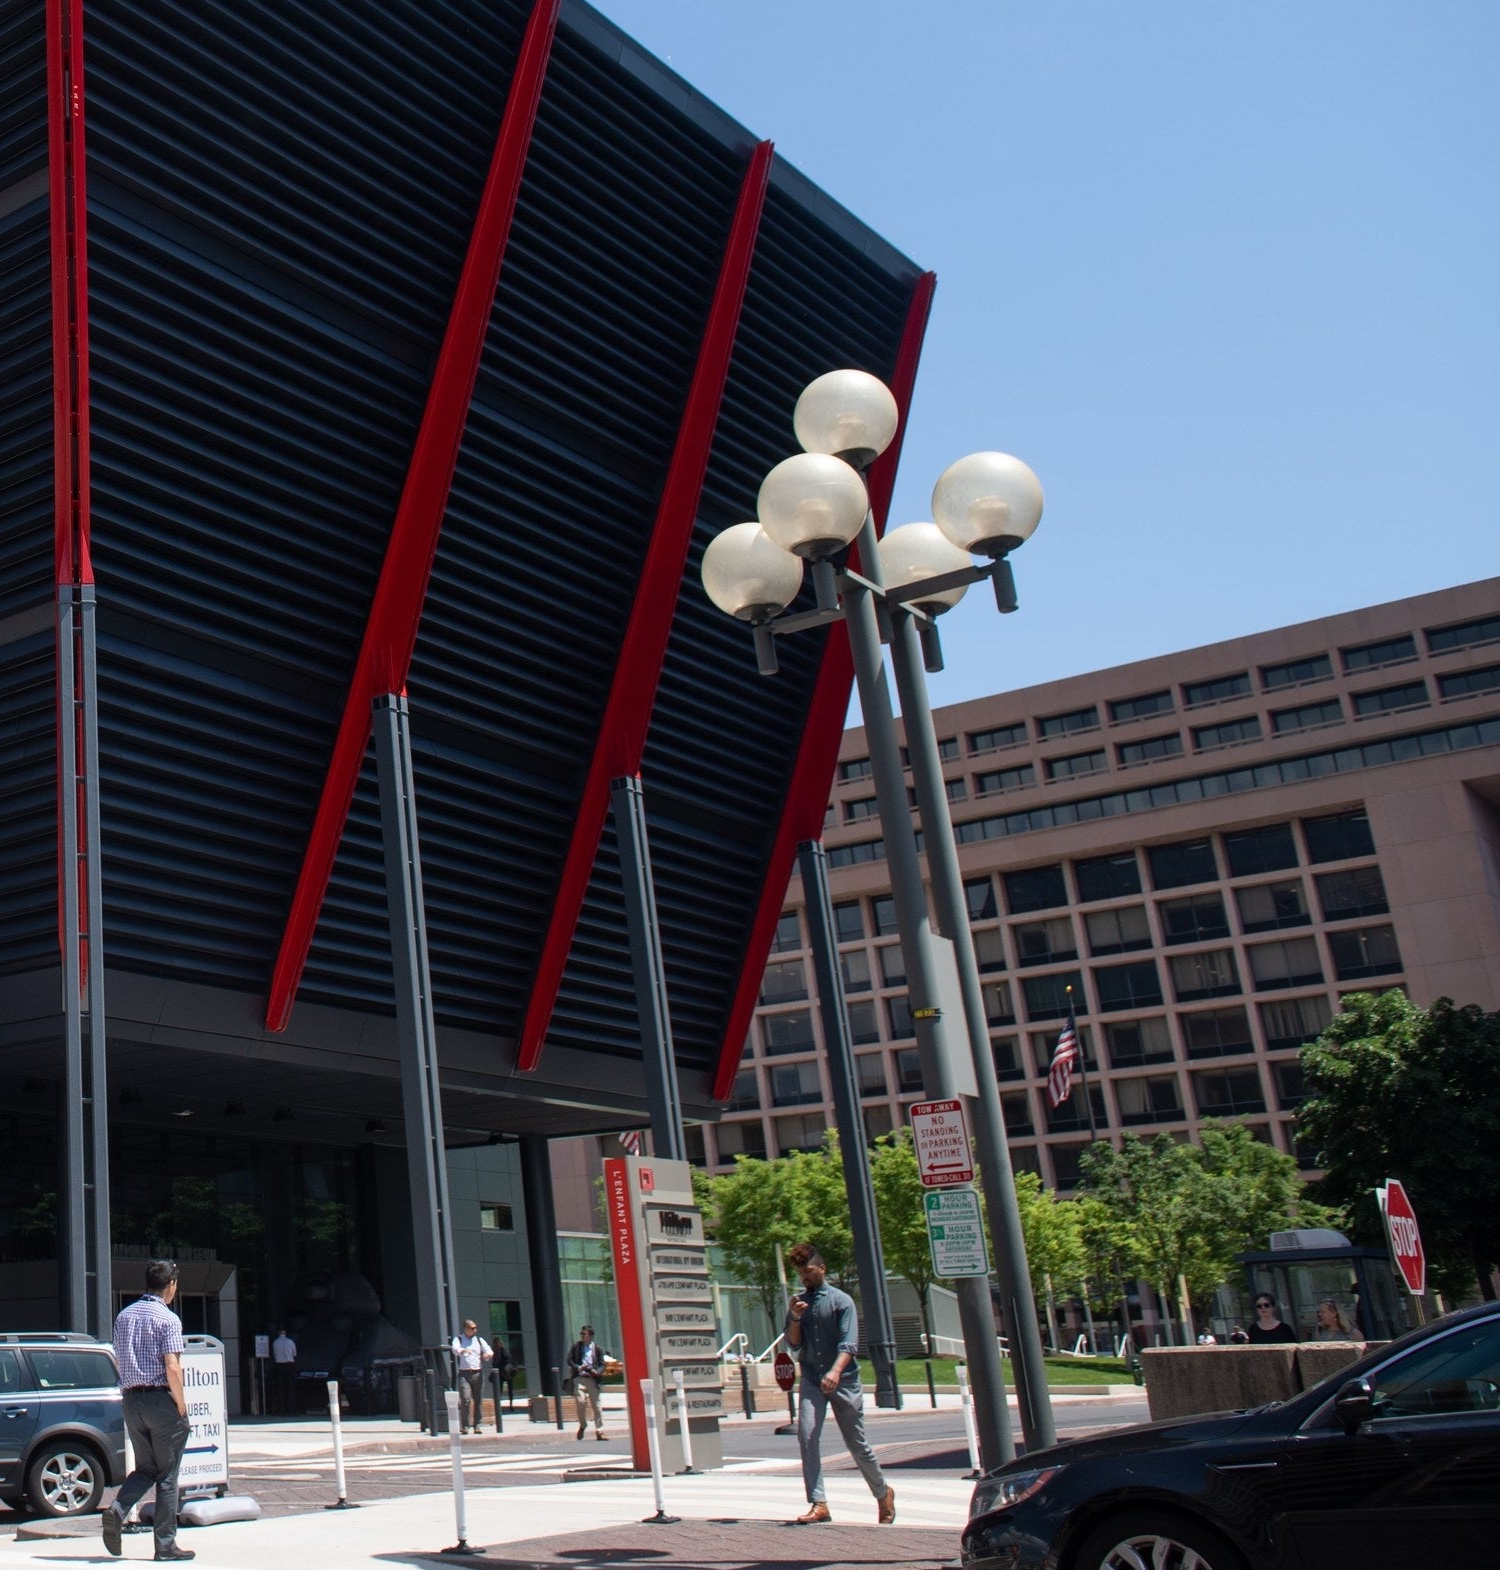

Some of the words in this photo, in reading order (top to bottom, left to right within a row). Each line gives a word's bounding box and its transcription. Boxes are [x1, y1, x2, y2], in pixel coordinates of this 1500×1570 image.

[917, 1105, 932, 1114] TOW
[934, 1102, 954, 1113] AWAY
[931, 1116, 944, 1125] NO
[921, 1126, 959, 1138] STANDING
[921, 1141, 928, 1149] OR
[929, 1137, 963, 1148] PARKING
[928, 1148, 962, 1159] ANYTIME
[613, 1170, 626, 1224] L'ENFANT
[931, 1197, 938, 1208] 2
[944, 1194, 967, 1202] HOUR
[941, 1201, 972, 1209] PARKING
[948, 1225, 972, 1233] HOUR
[947, 1232, 977, 1240] PARKING
[1389, 1215, 1418, 1257] STOP
[619, 1228, 631, 1265] PLAZA
[695, 1314, 708, 1322] PLAZA
[698, 1338, 711, 1346] PLAZA
[776, 1364, 793, 1379] STOP
[188, 1402, 212, 1417] UBER,
[190, 1424, 201, 1438] FT,
[203, 1423, 221, 1437] TAXI
[199, 1463, 223, 1475] PROCEED
